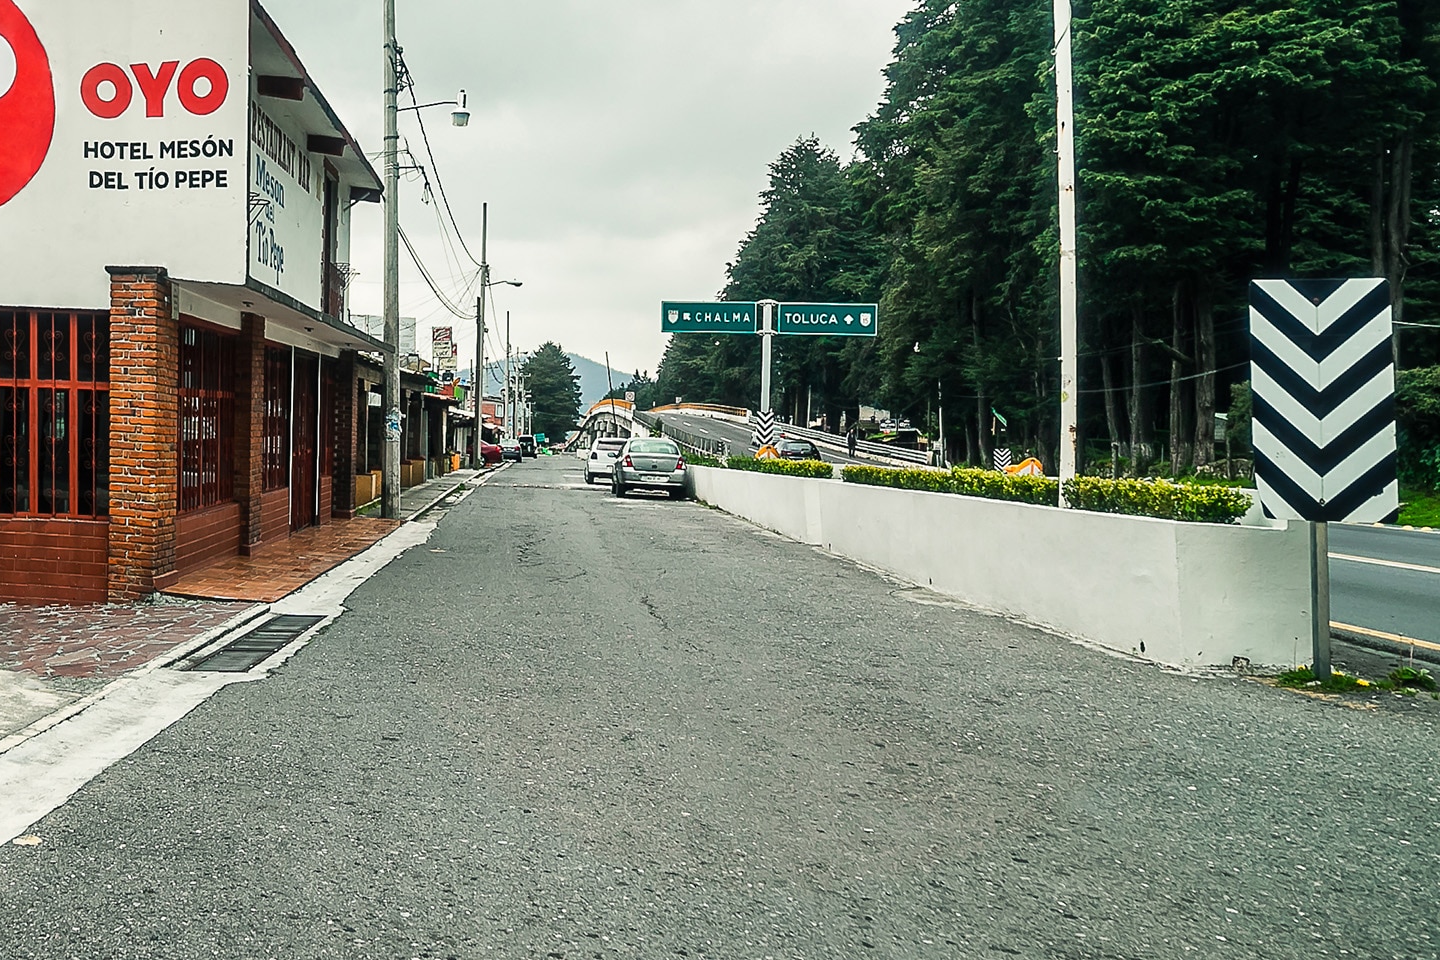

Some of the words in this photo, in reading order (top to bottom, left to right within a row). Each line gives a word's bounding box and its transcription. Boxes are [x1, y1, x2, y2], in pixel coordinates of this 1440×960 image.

[80, 58, 229, 119] OYO
[83, 141, 153, 160] HOTEL
[159, 134, 233, 159] MESÓN
[89, 171, 128, 189] DEL
[134, 166, 169, 189] TÍO
[175, 170, 227, 188] PEPE
[695, 309, 751, 323] CHALMA
[785, 313, 838, 325] TOLUCA
